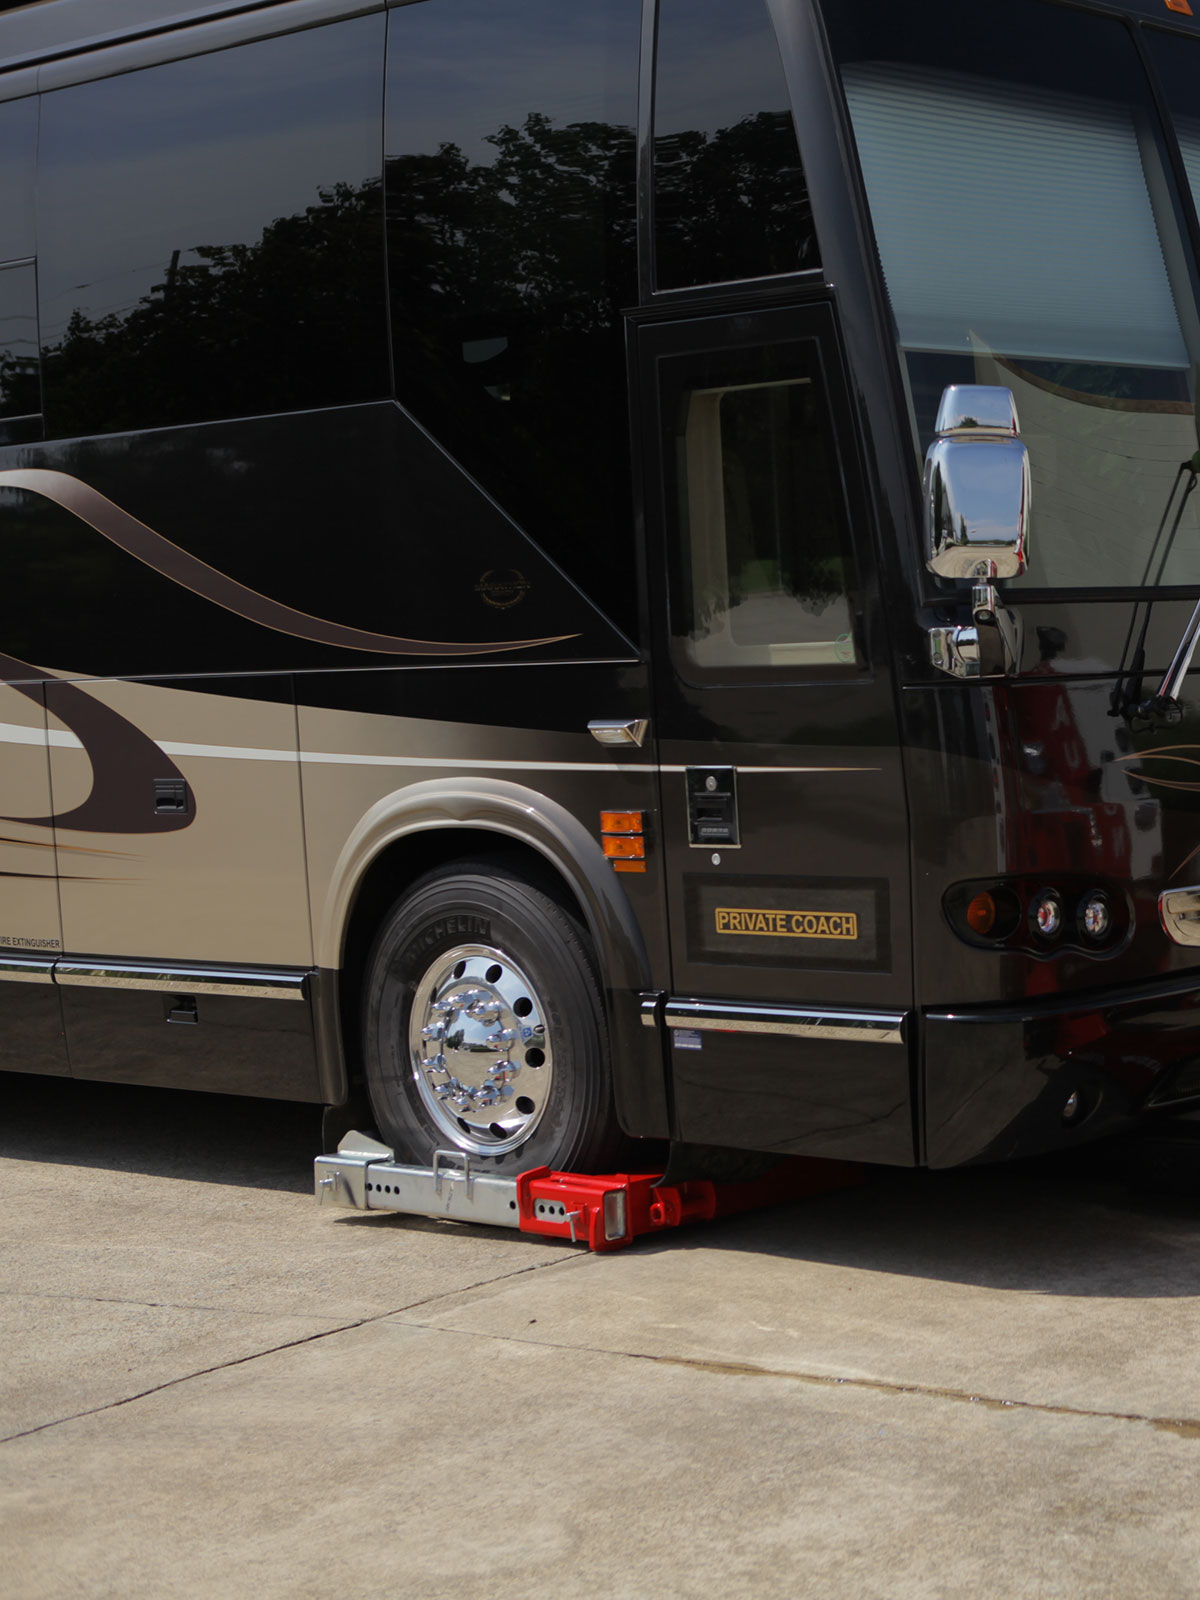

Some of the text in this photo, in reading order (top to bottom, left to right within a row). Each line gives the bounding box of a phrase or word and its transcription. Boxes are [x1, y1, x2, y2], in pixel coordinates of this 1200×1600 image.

[719, 912, 854, 935] PRIVATE COACH
[0, 936, 61, 949] IRE EXTINGUISHER
[404, 916, 491, 966] MICHELIN
